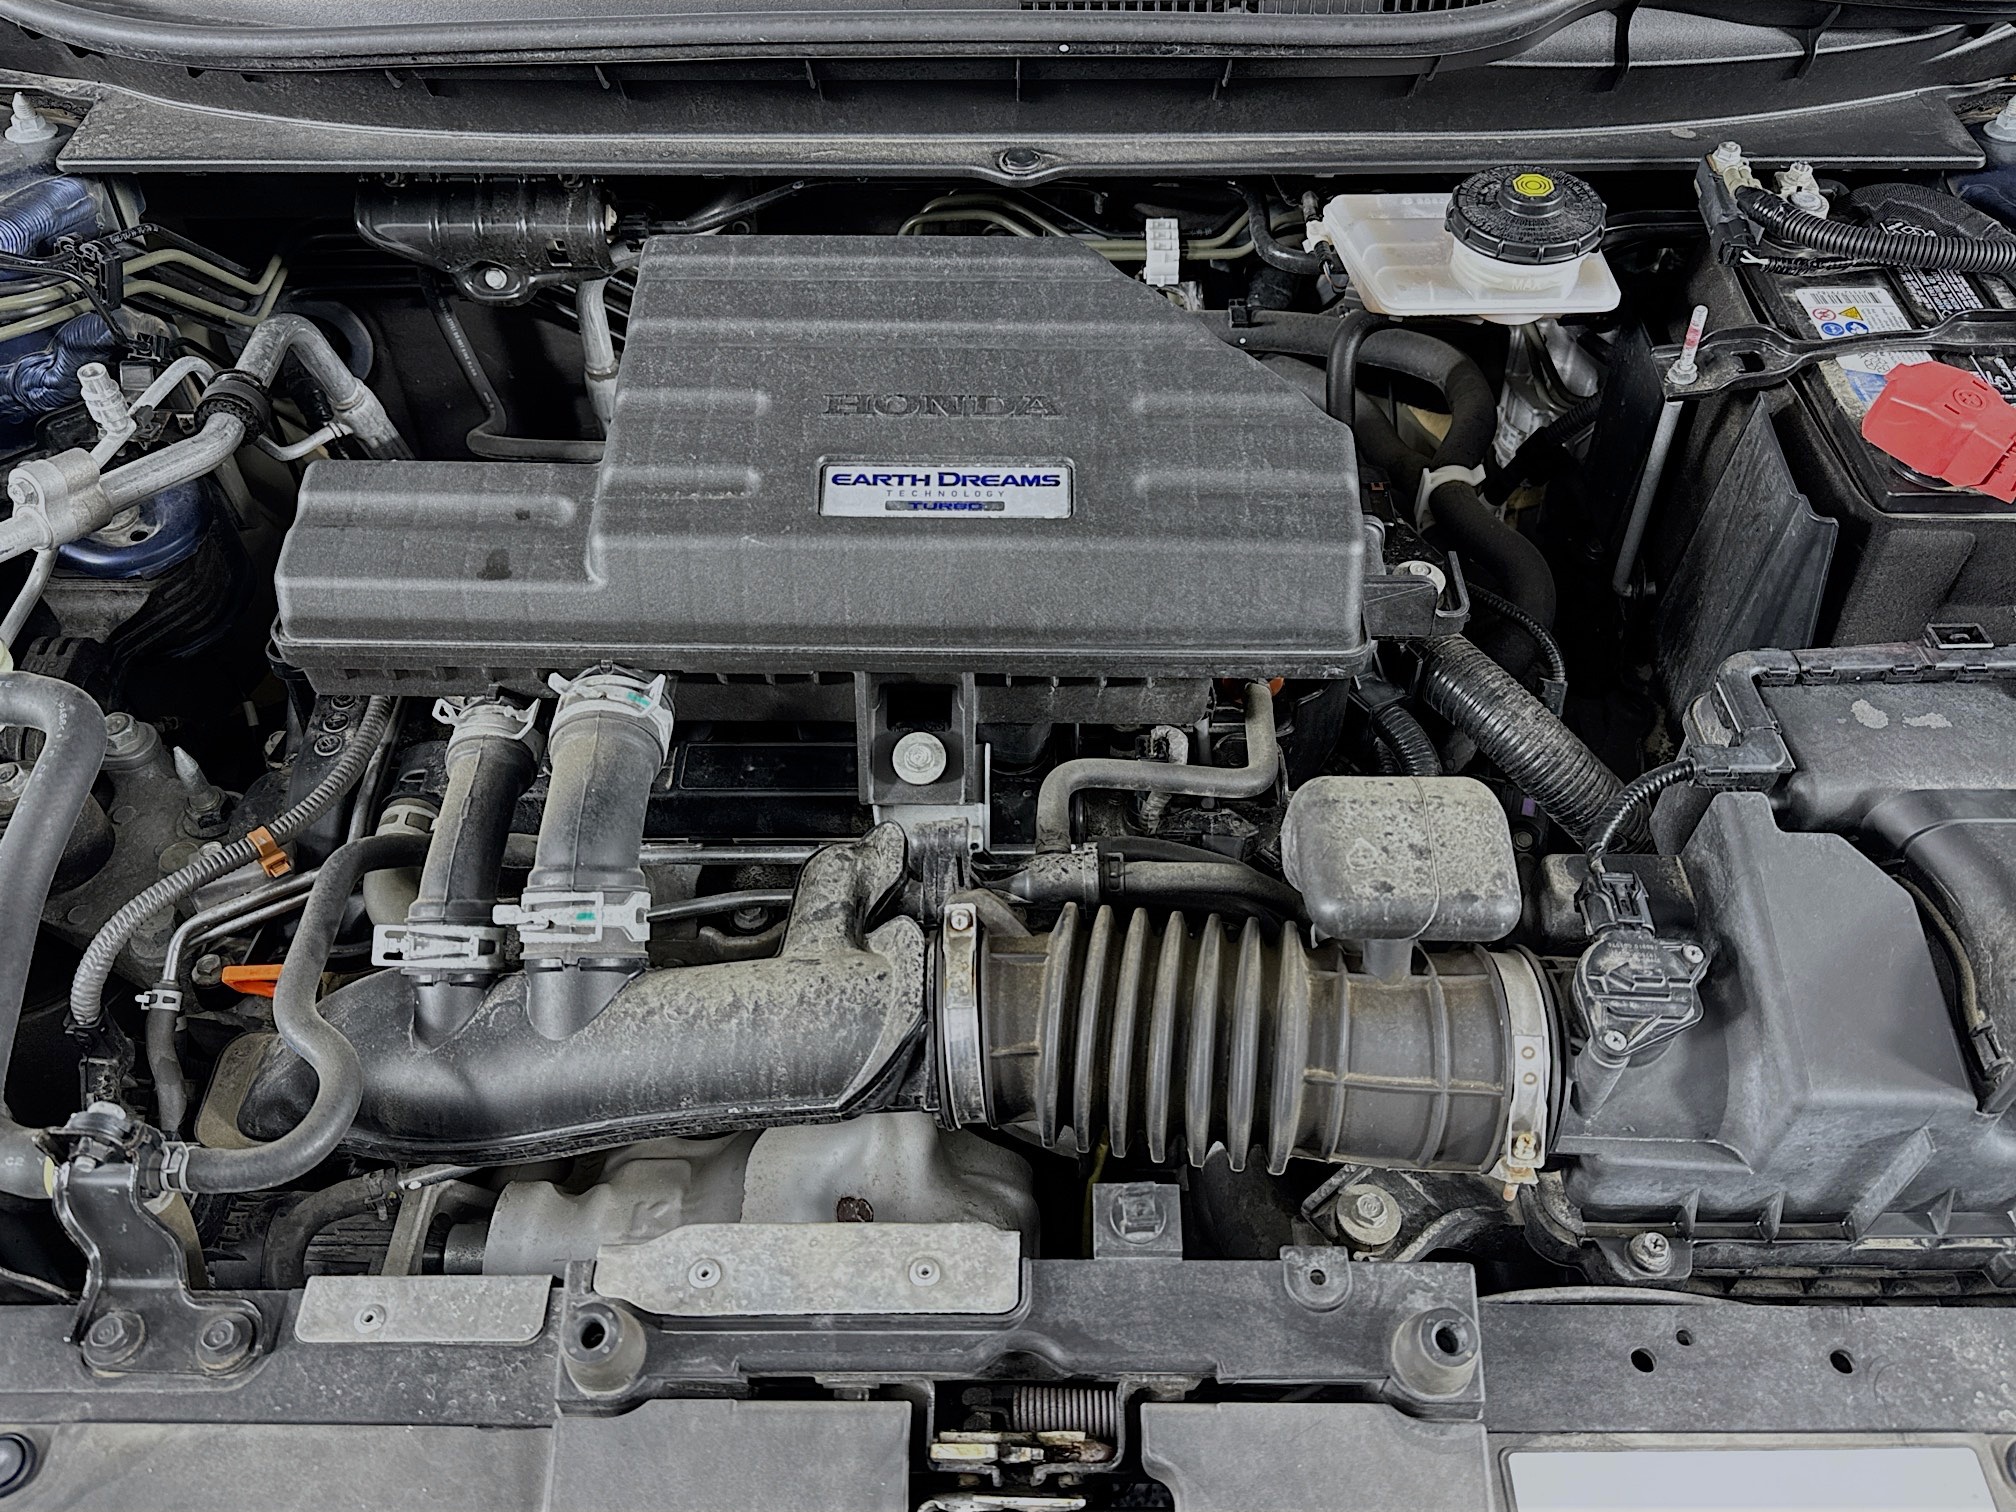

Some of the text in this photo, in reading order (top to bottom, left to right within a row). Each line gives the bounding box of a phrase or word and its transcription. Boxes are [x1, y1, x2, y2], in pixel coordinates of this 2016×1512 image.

[821, 394, 1067, 419] HONDA
[831, 472, 1061, 487] EARTH DREAMS
[886, 489, 1006, 498] TECHNOLOGY
[908, 501, 984, 511] TURBO
